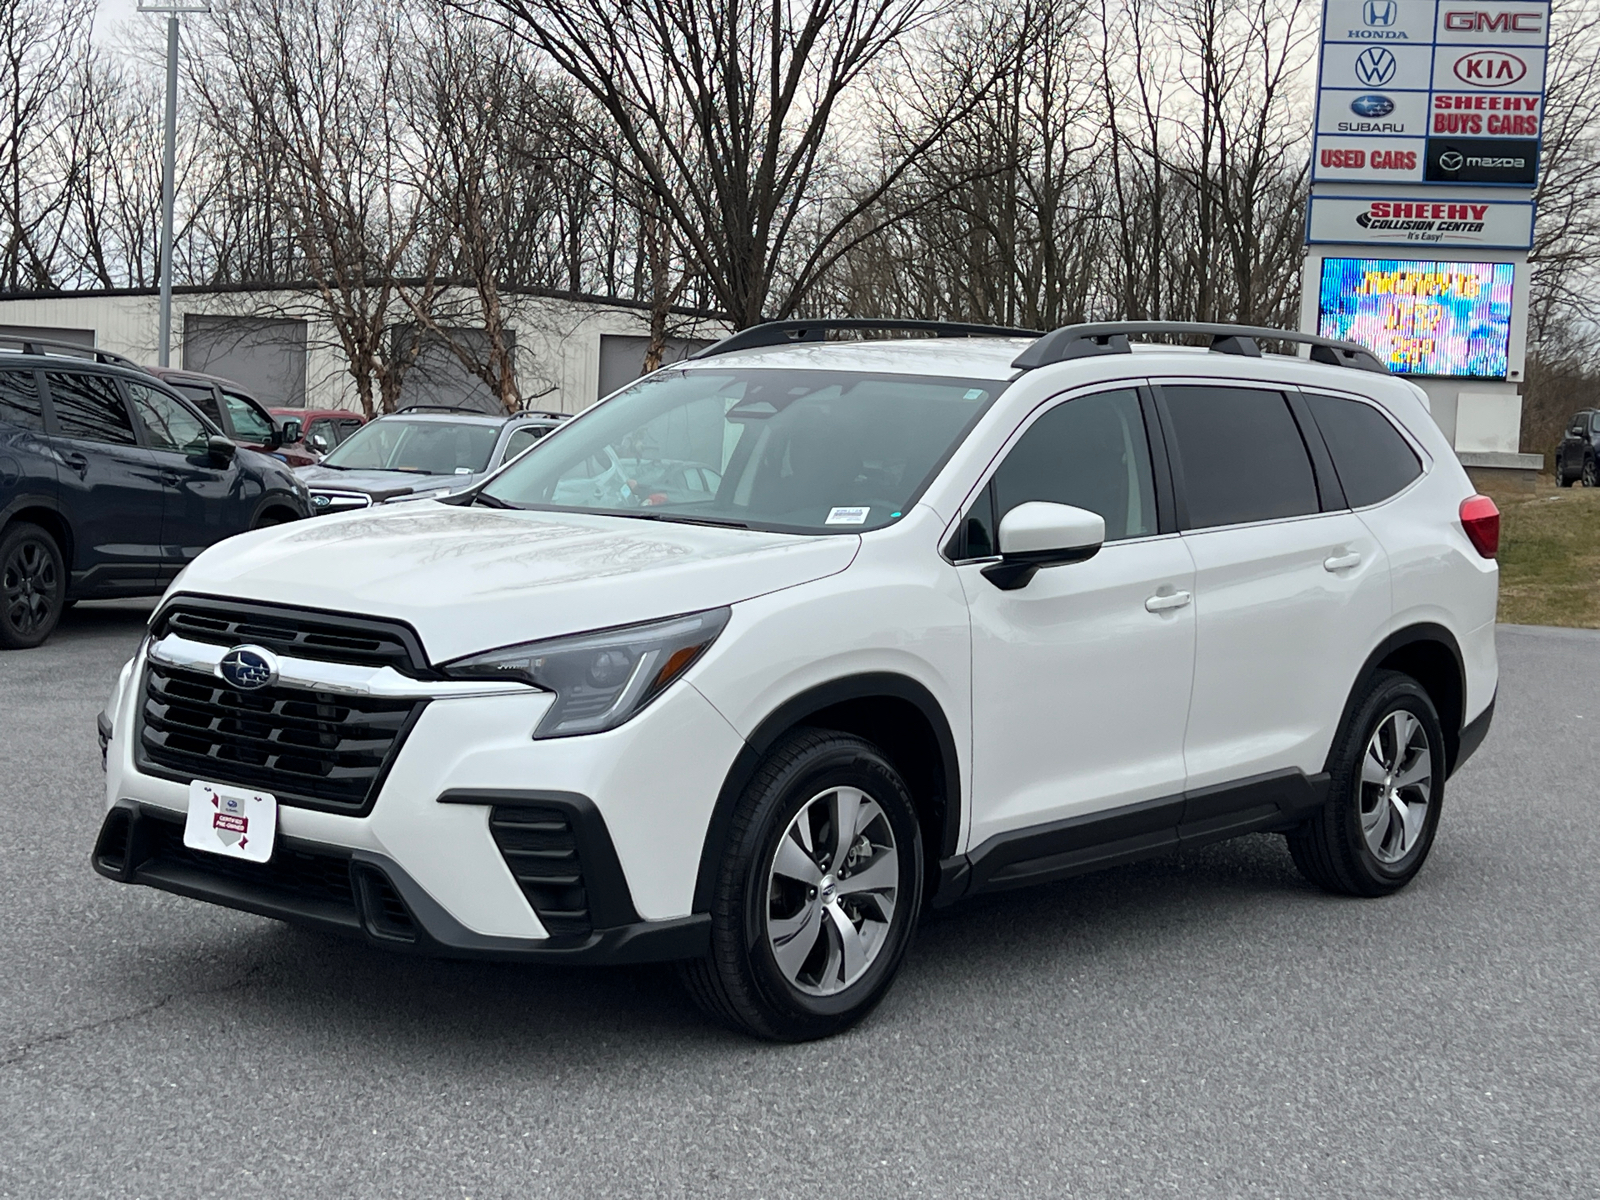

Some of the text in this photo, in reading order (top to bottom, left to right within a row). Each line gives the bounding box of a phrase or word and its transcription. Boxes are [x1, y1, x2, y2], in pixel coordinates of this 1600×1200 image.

[1445, 11, 1542, 33] GMC
[1347, 30, 1409, 39] HONDA
[1466, 60, 1514, 79] KIA
[1434, 95, 1540, 111] SHEEHY
[1337, 122, 1405, 133] SUBARU
[1433, 113, 1538, 135] BUYS CARS
[1320, 149, 1417, 170] USED CARS
[1466, 157, 1526, 168] mazda
[1370, 202, 1489, 220] SHEEHY
[1369, 219, 1485, 232] COLLISION CENTER
[1407, 231, 1443, 242] It's Easy!
